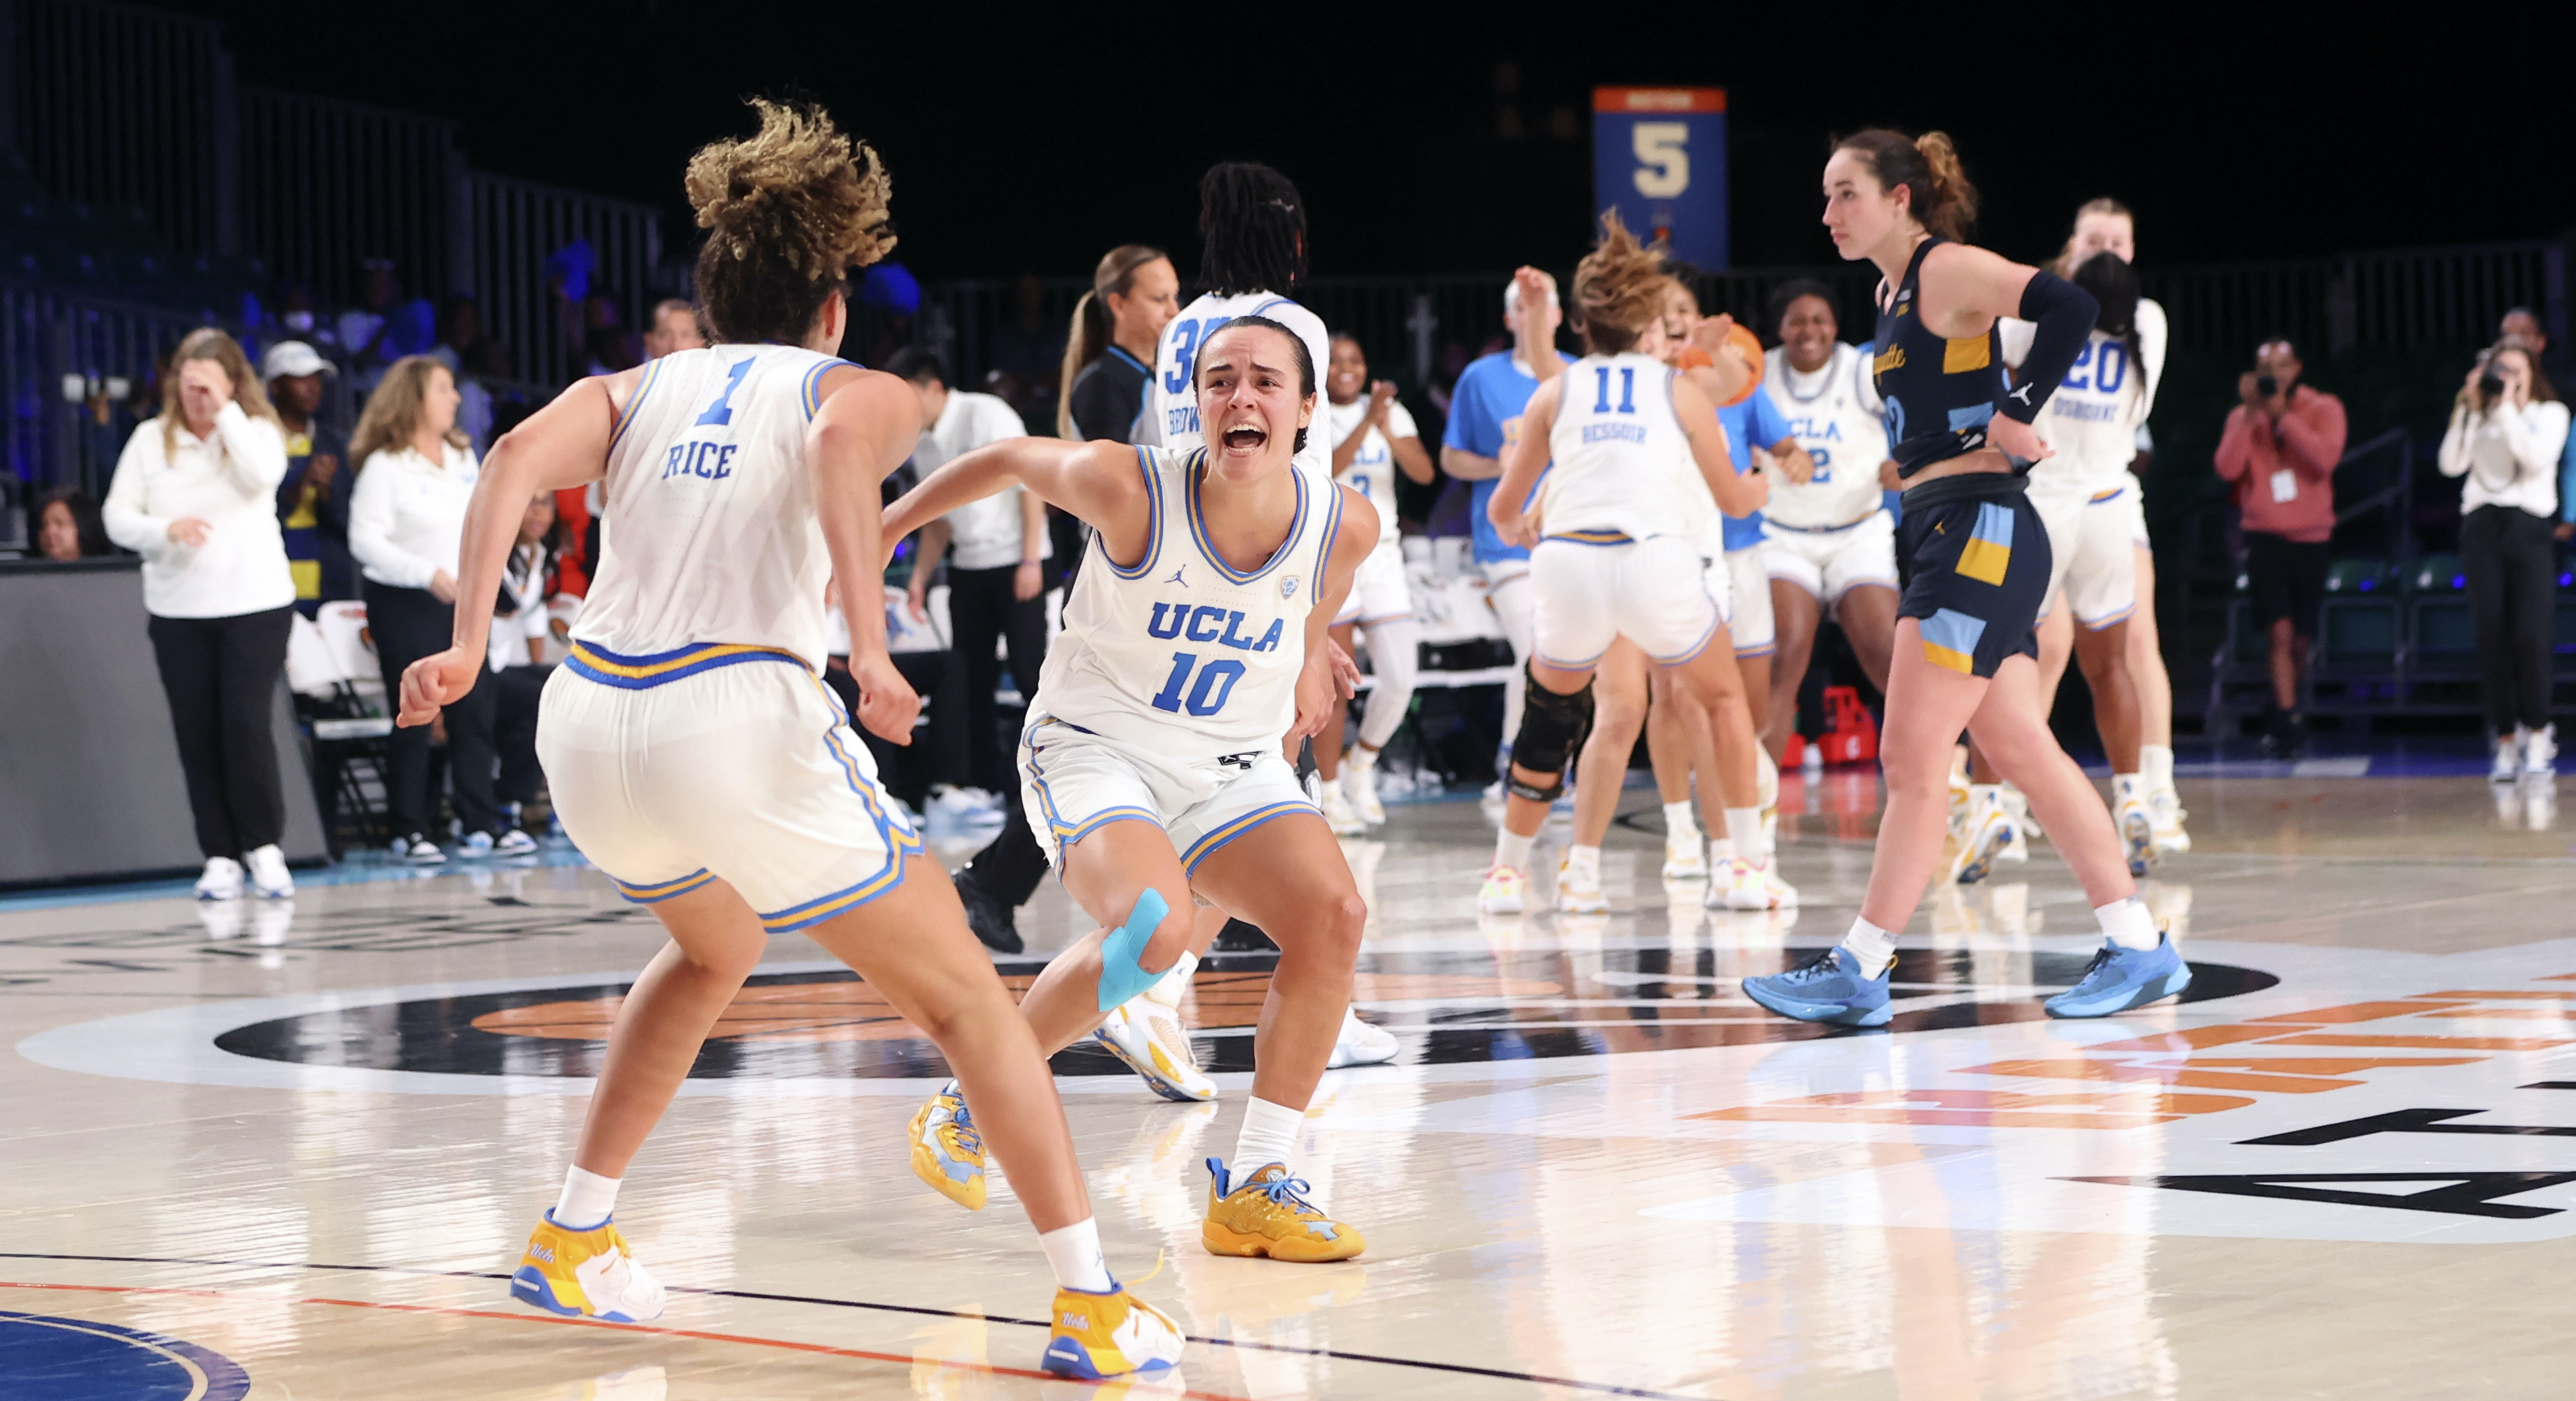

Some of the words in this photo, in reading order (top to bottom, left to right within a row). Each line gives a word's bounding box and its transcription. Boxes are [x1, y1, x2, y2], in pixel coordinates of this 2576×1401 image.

[1632, 121, 1690, 199] 5
[694, 356, 757, 427] 1
[1593, 367, 1636, 413] 11
[2060, 340, 2128, 393] 20
[1789, 418, 1843, 442] CLA
[661, 441, 737, 480] RICE
[1148, 602, 1284, 652] UCLA
[1151, 652, 1246, 717] 10
